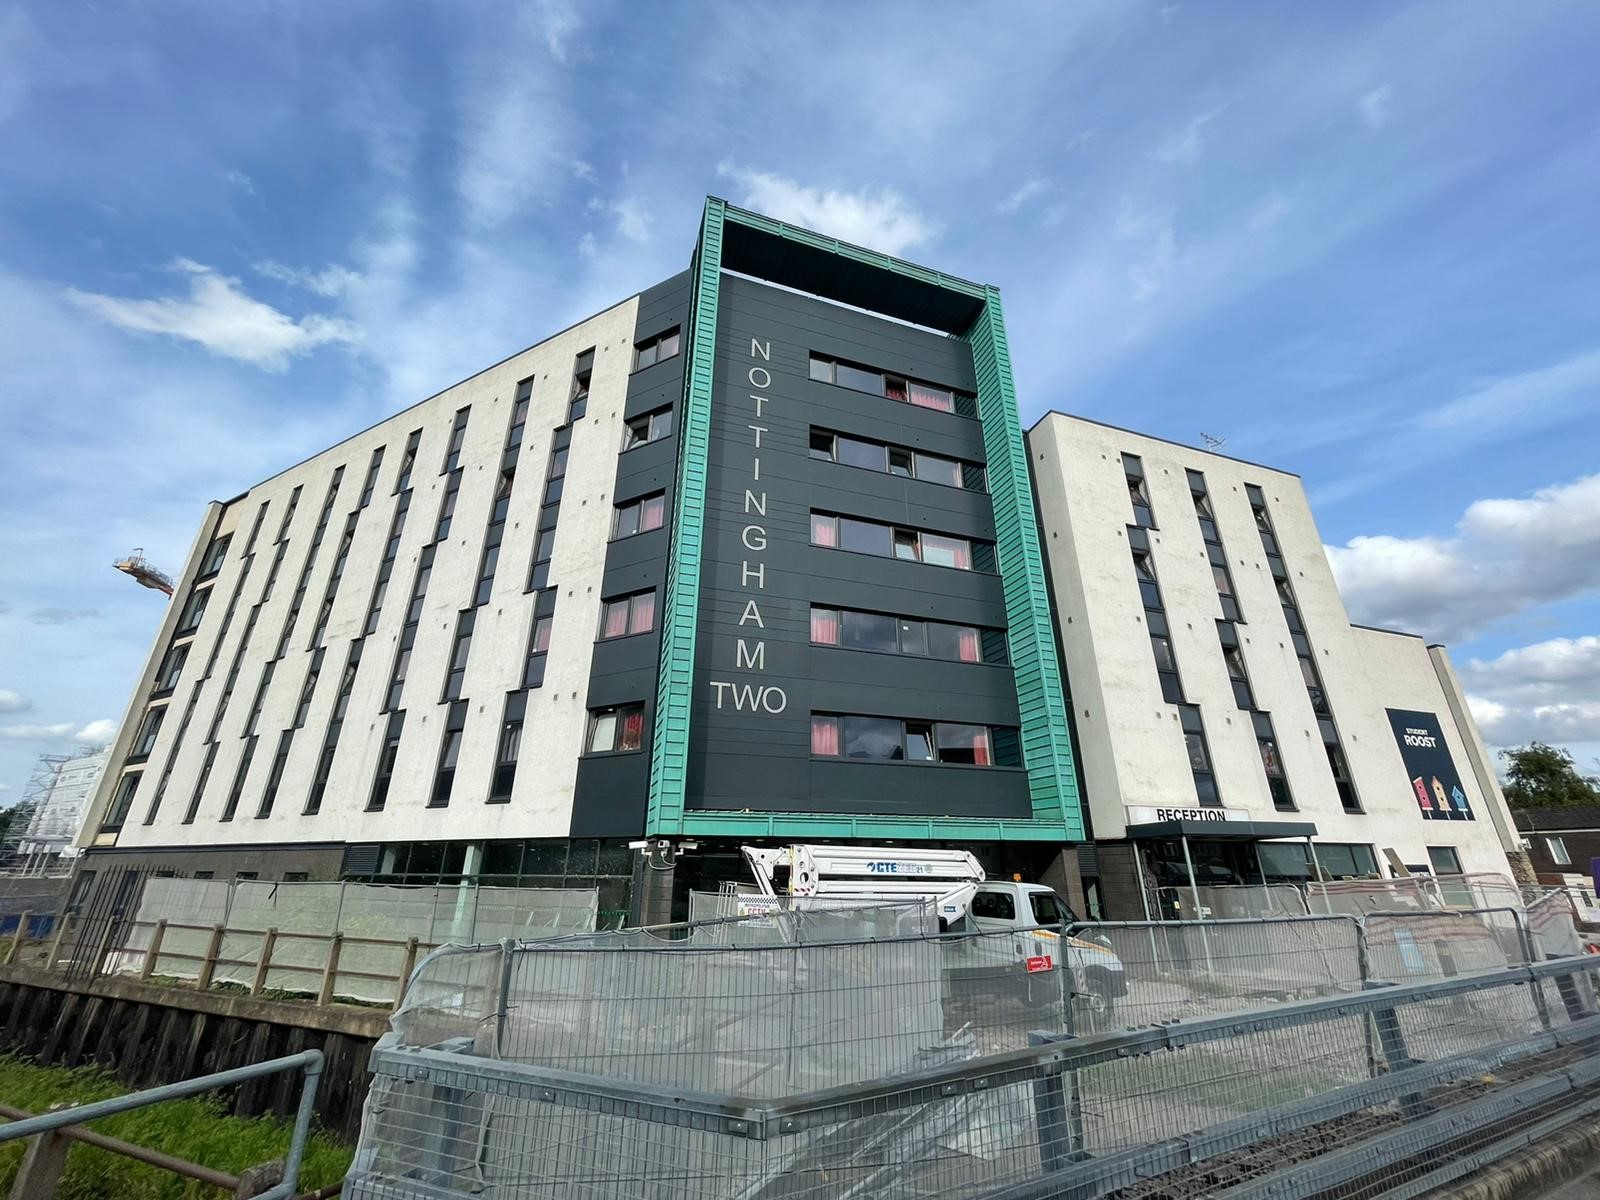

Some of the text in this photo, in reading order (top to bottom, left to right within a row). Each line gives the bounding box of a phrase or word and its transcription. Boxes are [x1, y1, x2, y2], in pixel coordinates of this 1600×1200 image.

[735, 337, 772, 670] NOTTINGHAM
[709, 680, 788, 714] TWO
[1405, 727, 1428, 736] STUDENT
[1403, 734, 1437, 748] ROOST
[1156, 808, 1226, 821] RECEPTION
[876, 861, 897, 873] CTE
